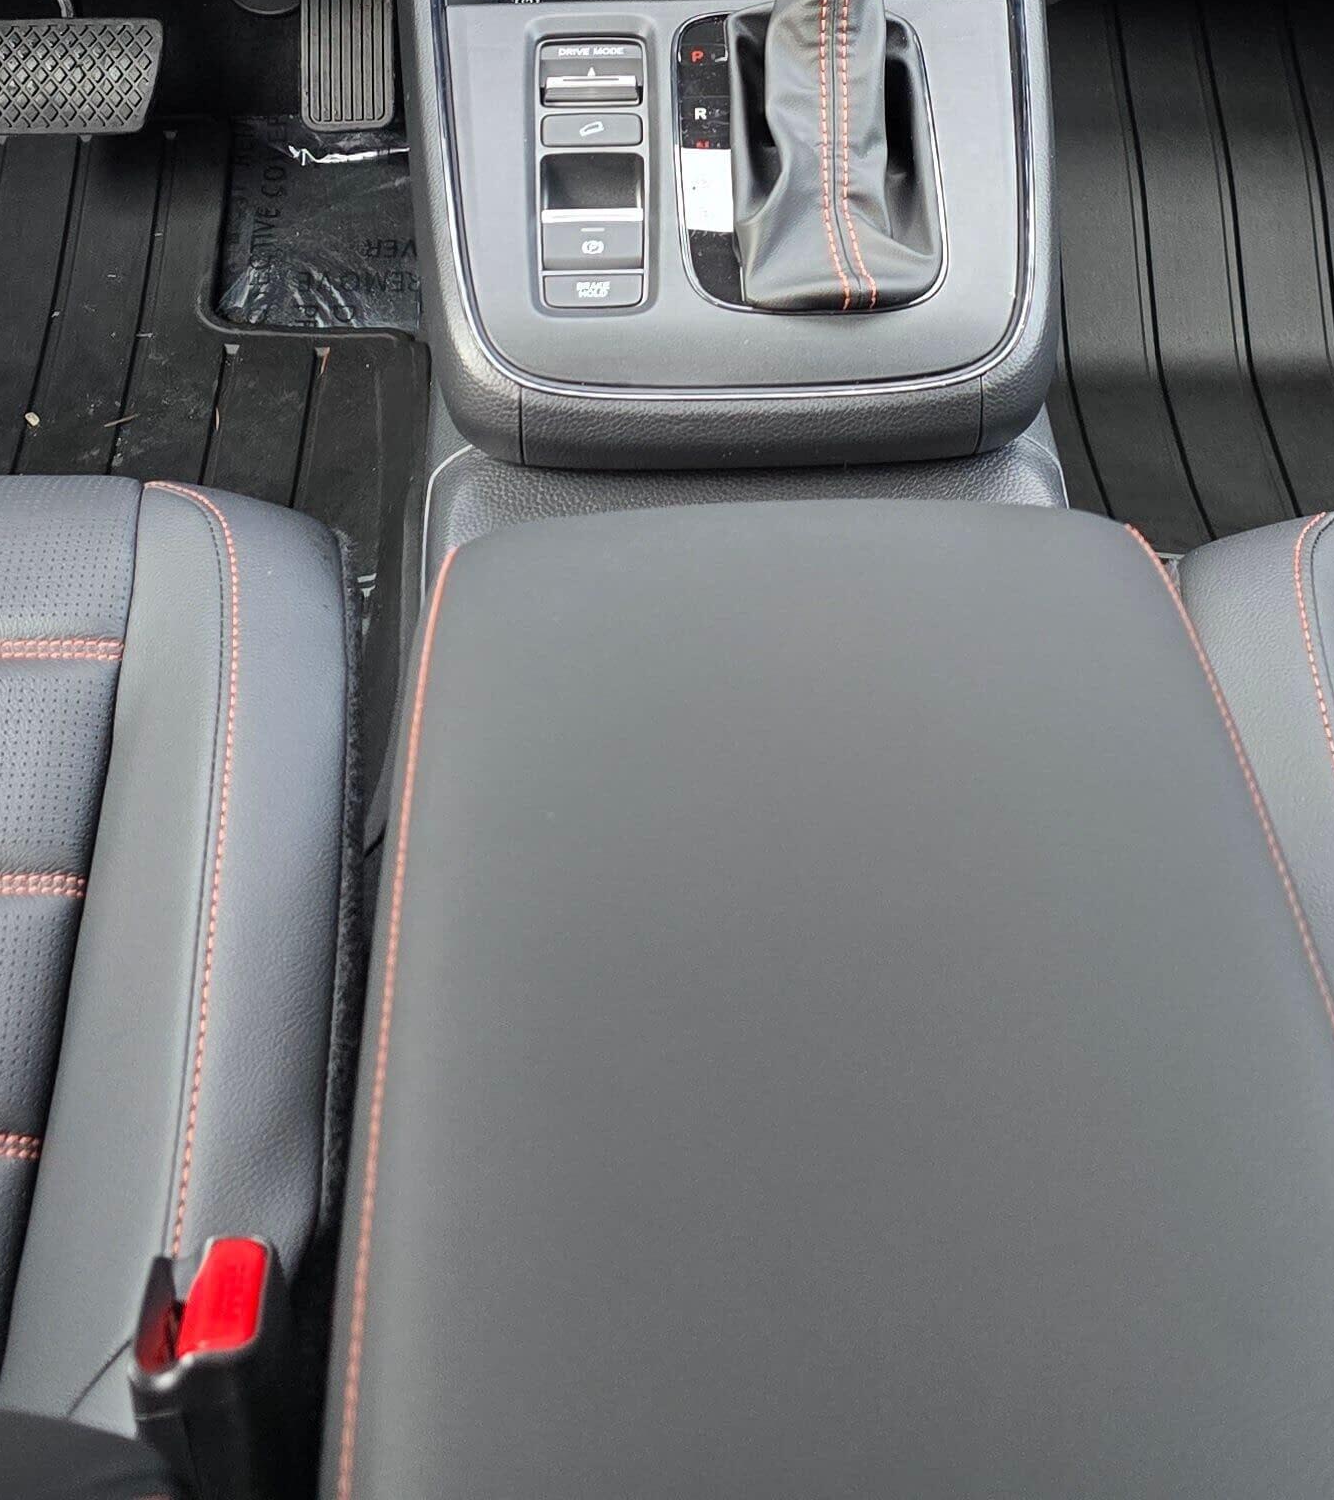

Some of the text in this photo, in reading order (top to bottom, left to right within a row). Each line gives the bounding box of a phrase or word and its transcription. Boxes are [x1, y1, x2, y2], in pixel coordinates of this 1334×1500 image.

[558, 47, 624, 56] DRIVE MODE
[691, 51, 704, 62] P
[694, 108, 707, 119] R
[577, 282, 610, 290] BRAKE
[579, 288, 608, 297] HOLD
